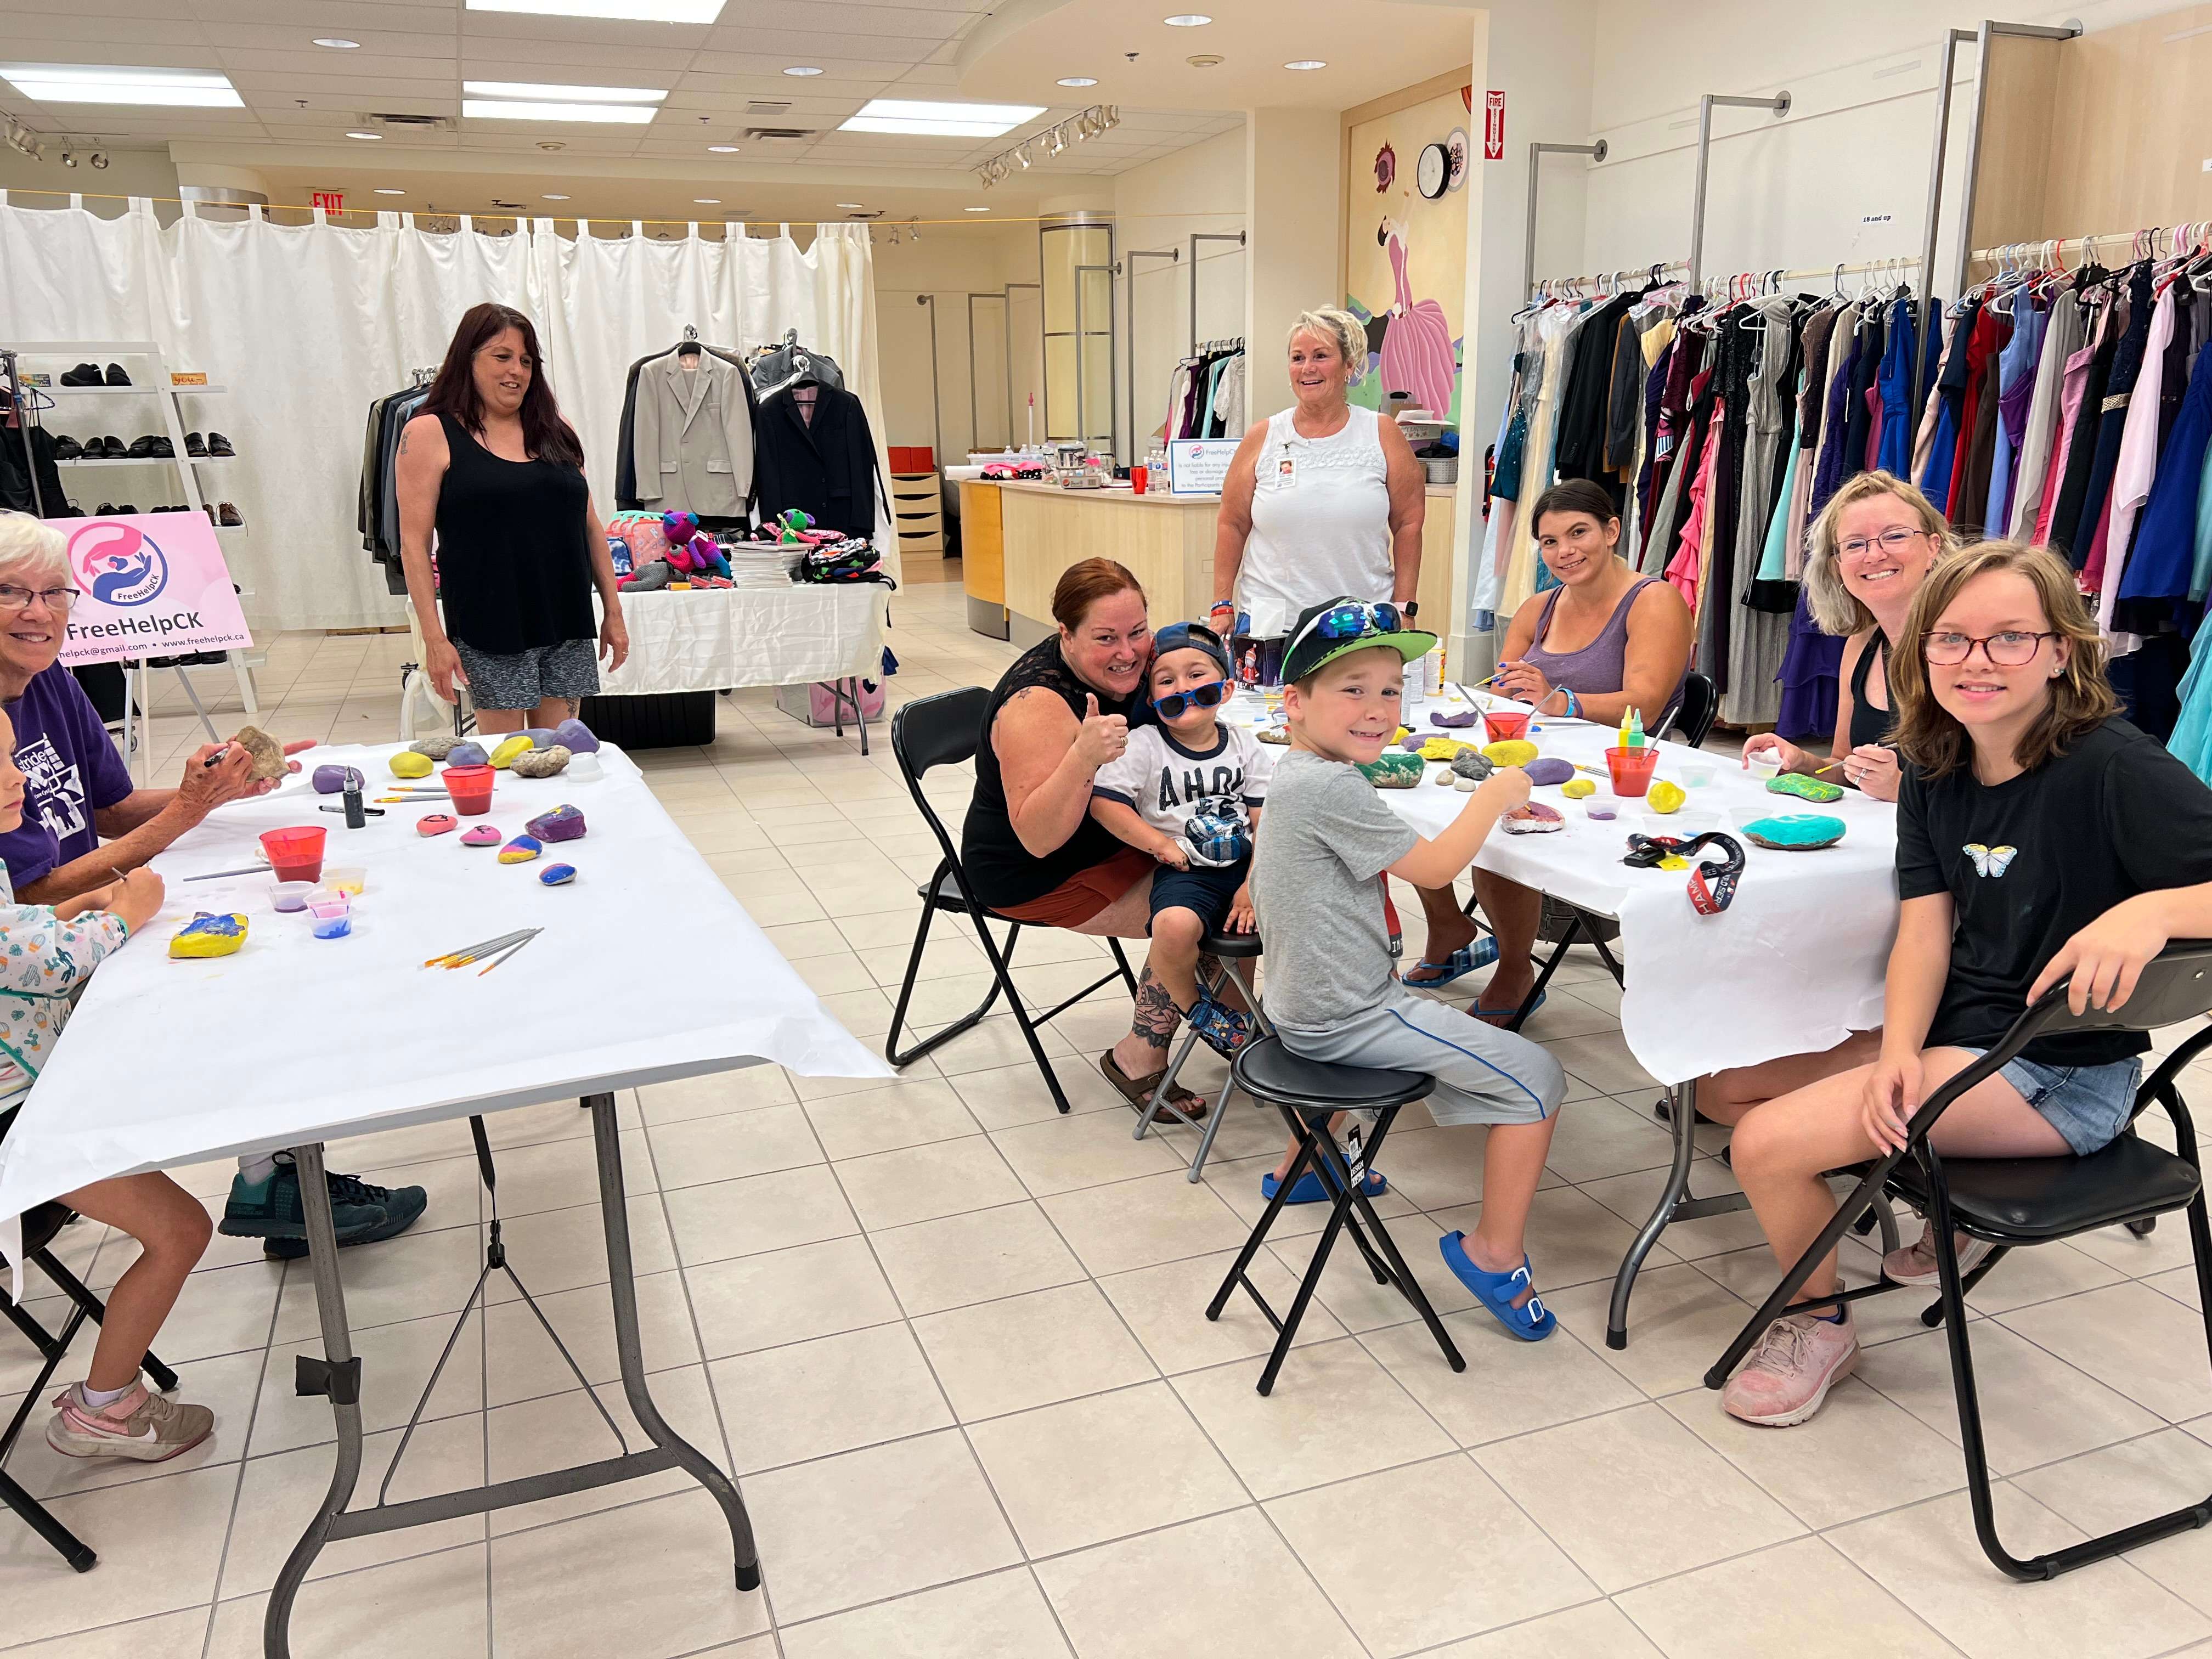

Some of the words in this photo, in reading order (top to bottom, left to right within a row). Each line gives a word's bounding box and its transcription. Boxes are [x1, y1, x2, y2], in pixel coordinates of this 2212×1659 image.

[1489, 98, 1502, 107] FIRE
[313, 193, 343, 216] EXIT
[118, 574, 159, 600] FreeHelpCK
[66, 612, 204, 640] FreeHelpCK
[161, 633, 245, 648] www.freehelpck.ca
